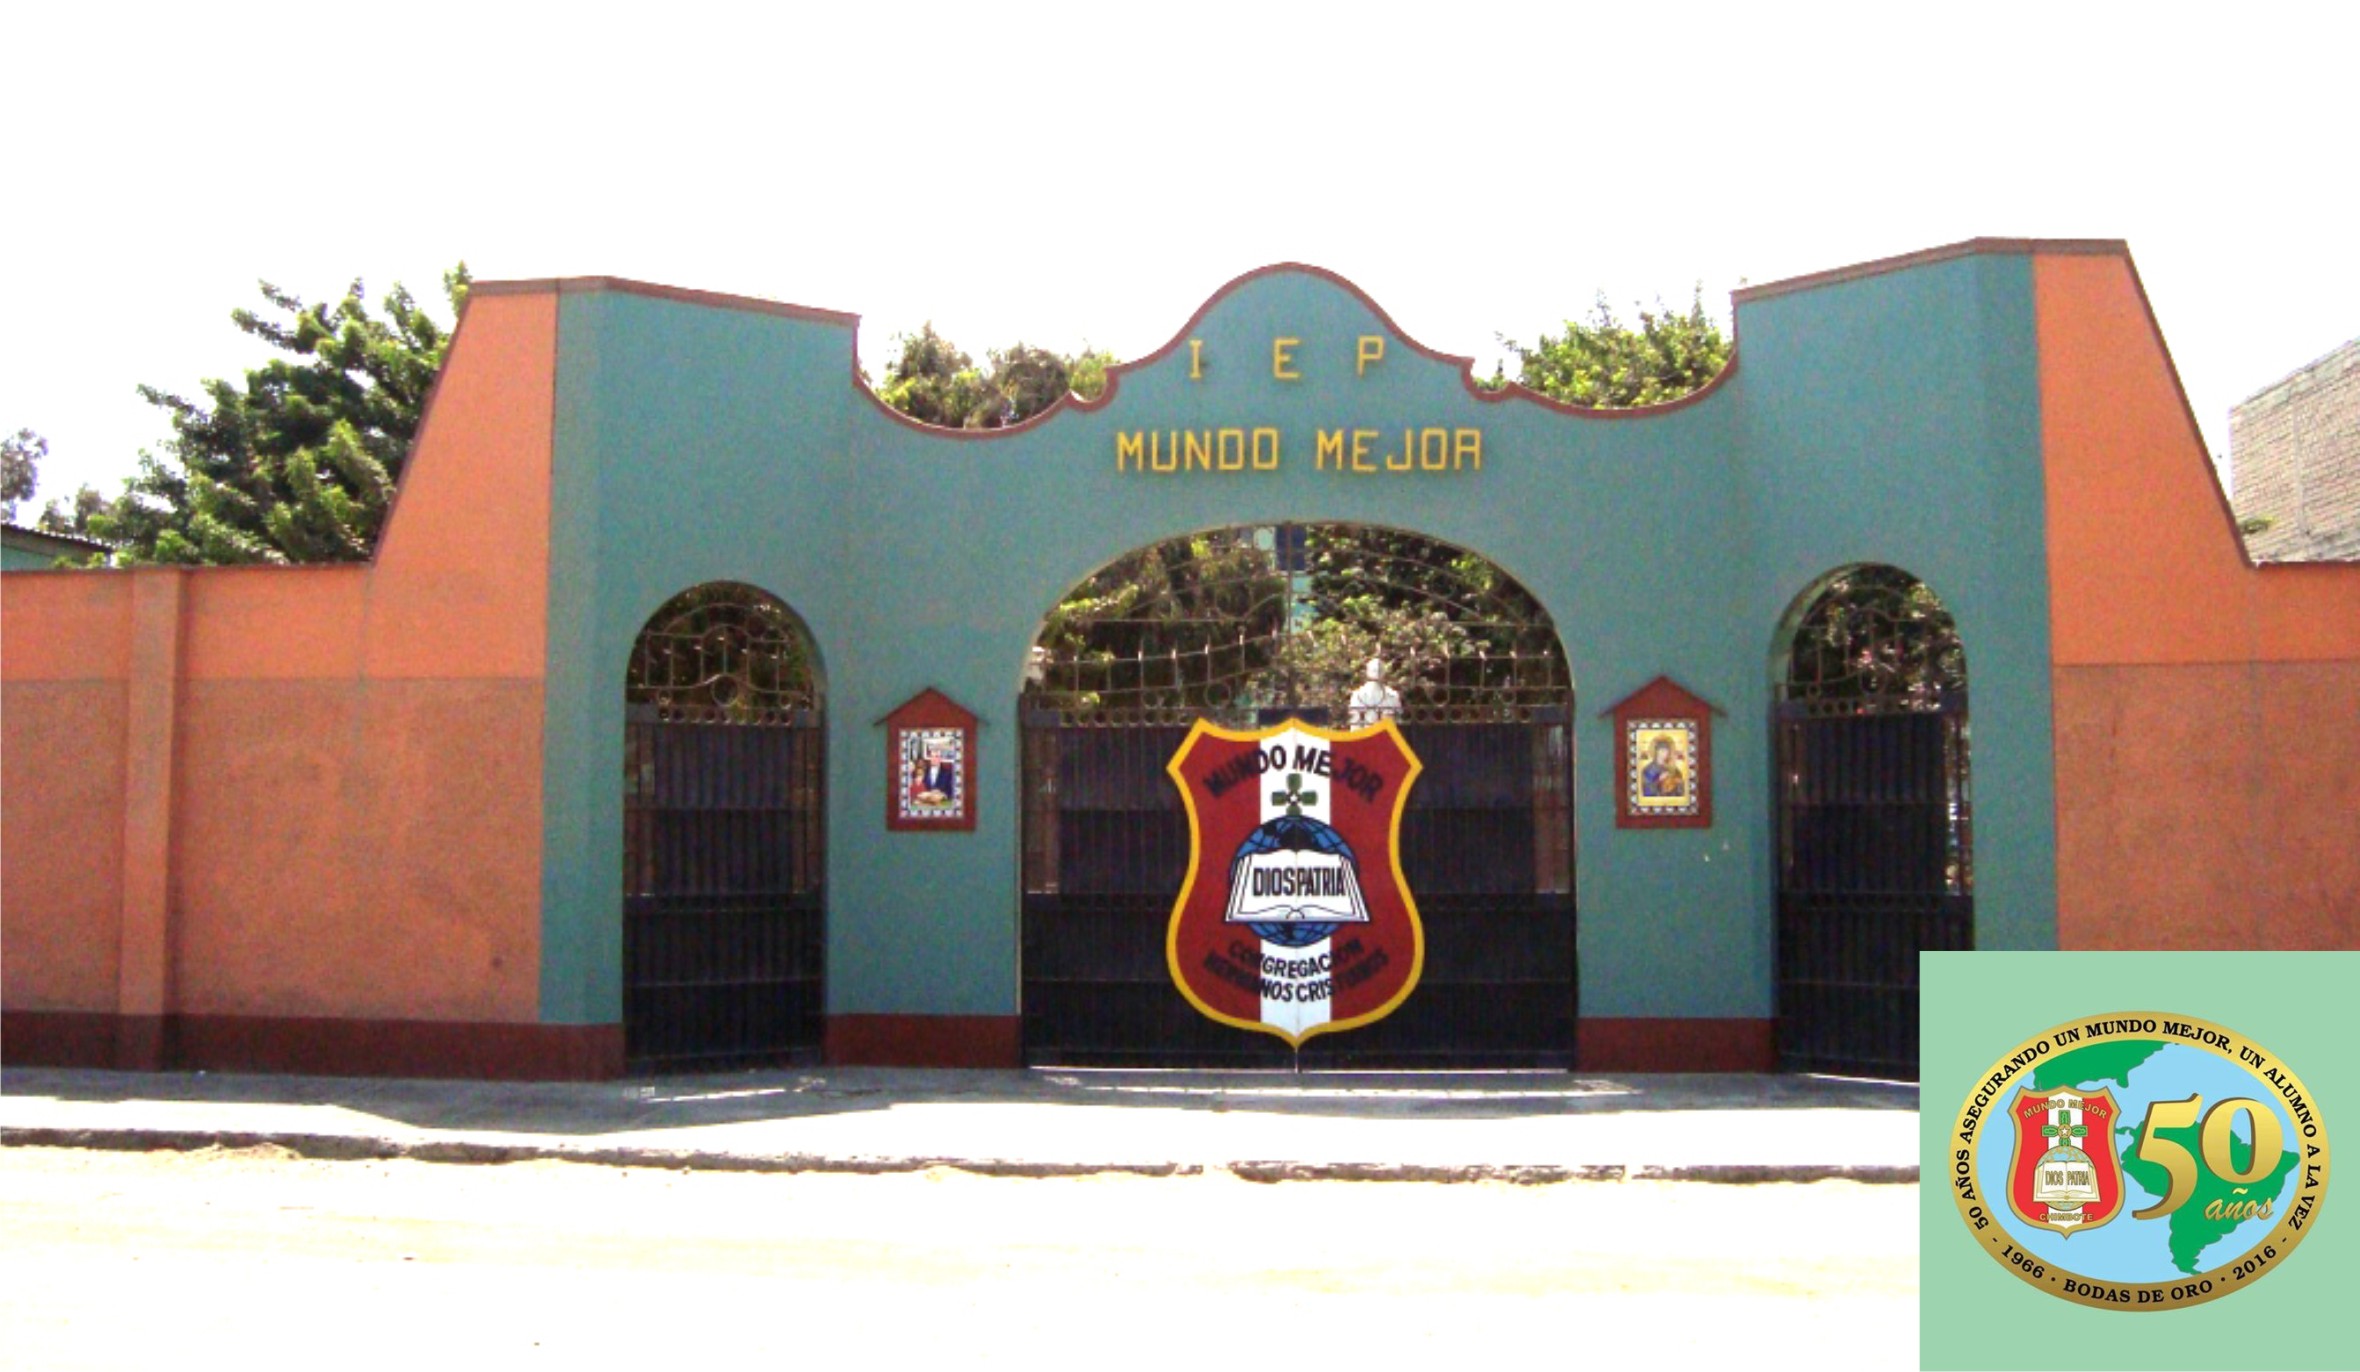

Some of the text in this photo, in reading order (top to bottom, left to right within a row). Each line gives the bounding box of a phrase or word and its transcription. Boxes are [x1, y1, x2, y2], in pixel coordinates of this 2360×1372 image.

[1189, 335, 1385, 379] I E P
[1116, 428, 1280, 472] MUNDO
[1204, 745, 1384, 803] MUNDO MEJOR
